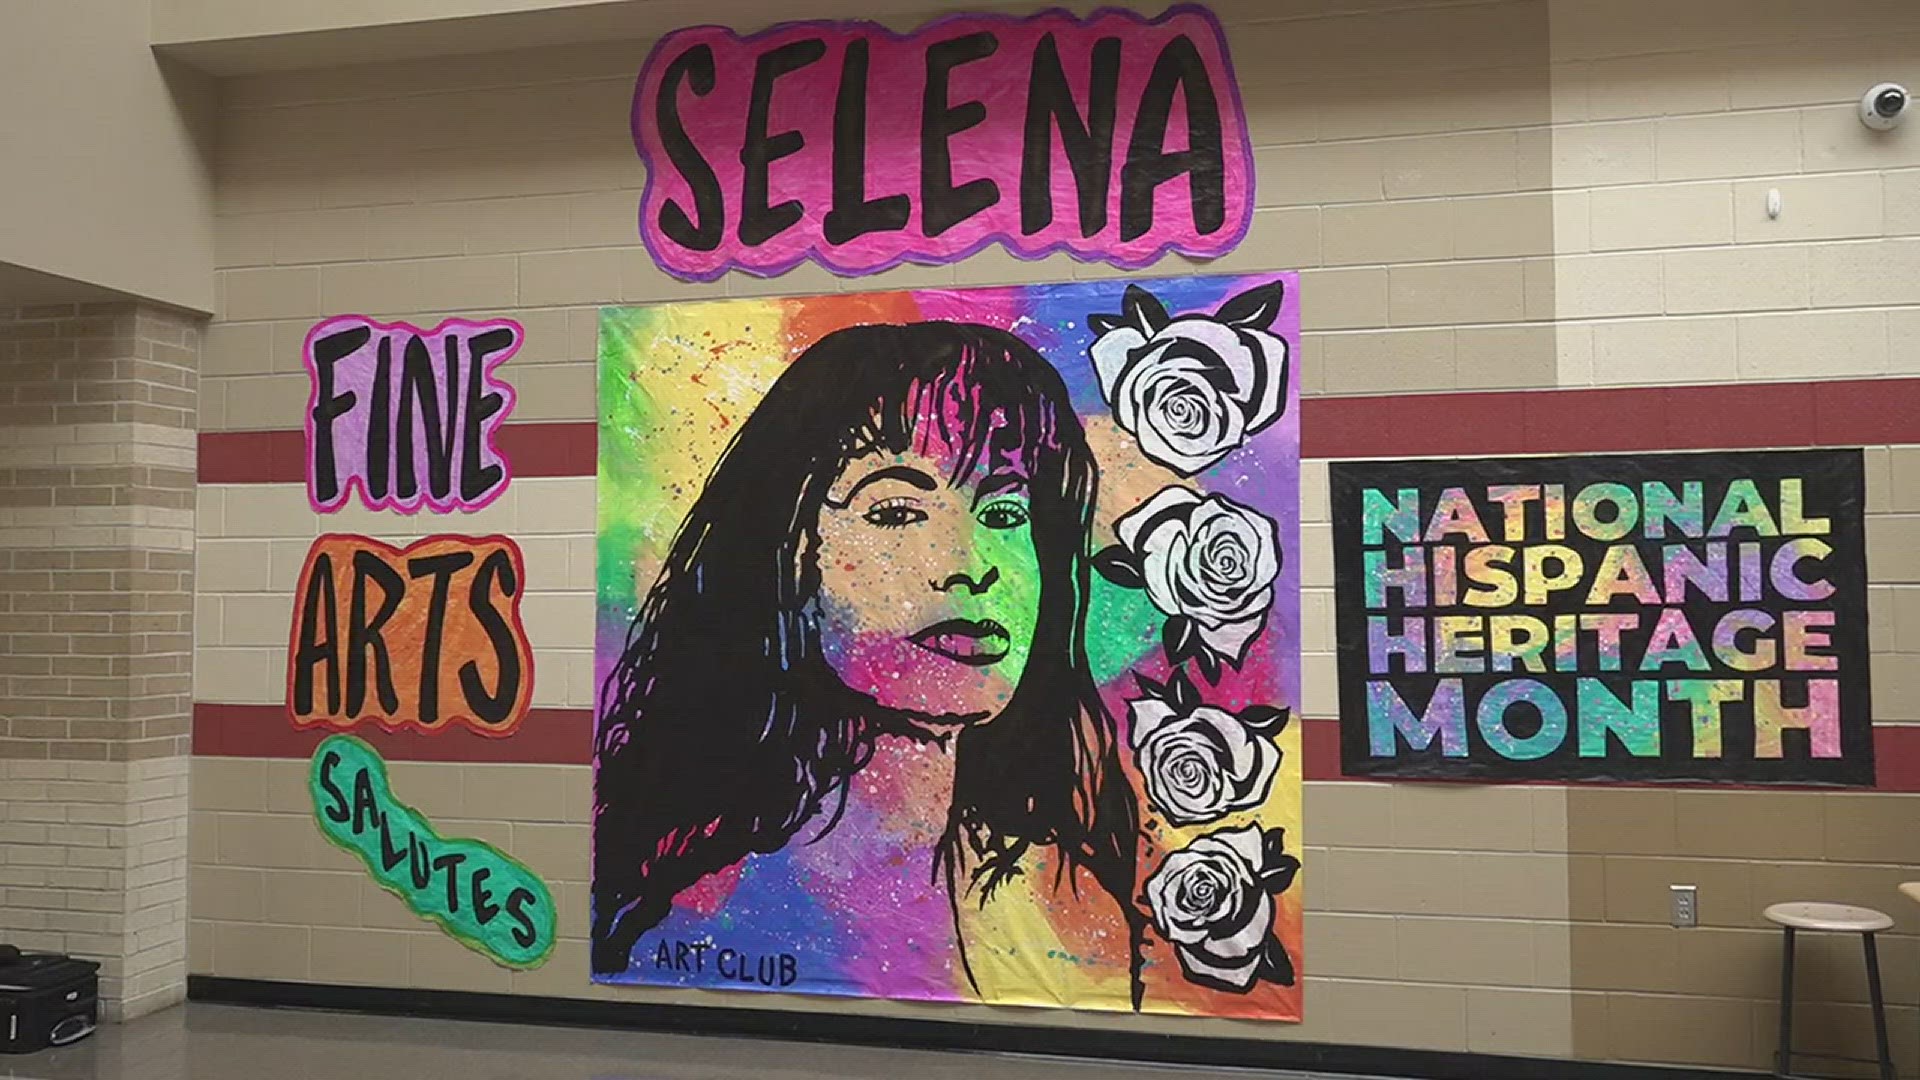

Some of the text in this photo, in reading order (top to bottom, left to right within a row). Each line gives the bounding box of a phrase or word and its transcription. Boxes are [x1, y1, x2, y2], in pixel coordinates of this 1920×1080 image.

[656, 31, 1224, 251] SELENA
[313, 325, 514, 502] FINE
[1362, 478, 1832, 545] NATIONAL
[1363, 538, 1837, 608] HISPANIC
[294, 549, 520, 724] ARTS
[1366, 608, 1839, 674] HERITAGE
[1366, 677, 1842, 761] MONTH
[319, 751, 538, 948] SALUTES
[655, 938, 798, 987] ART CLUB
